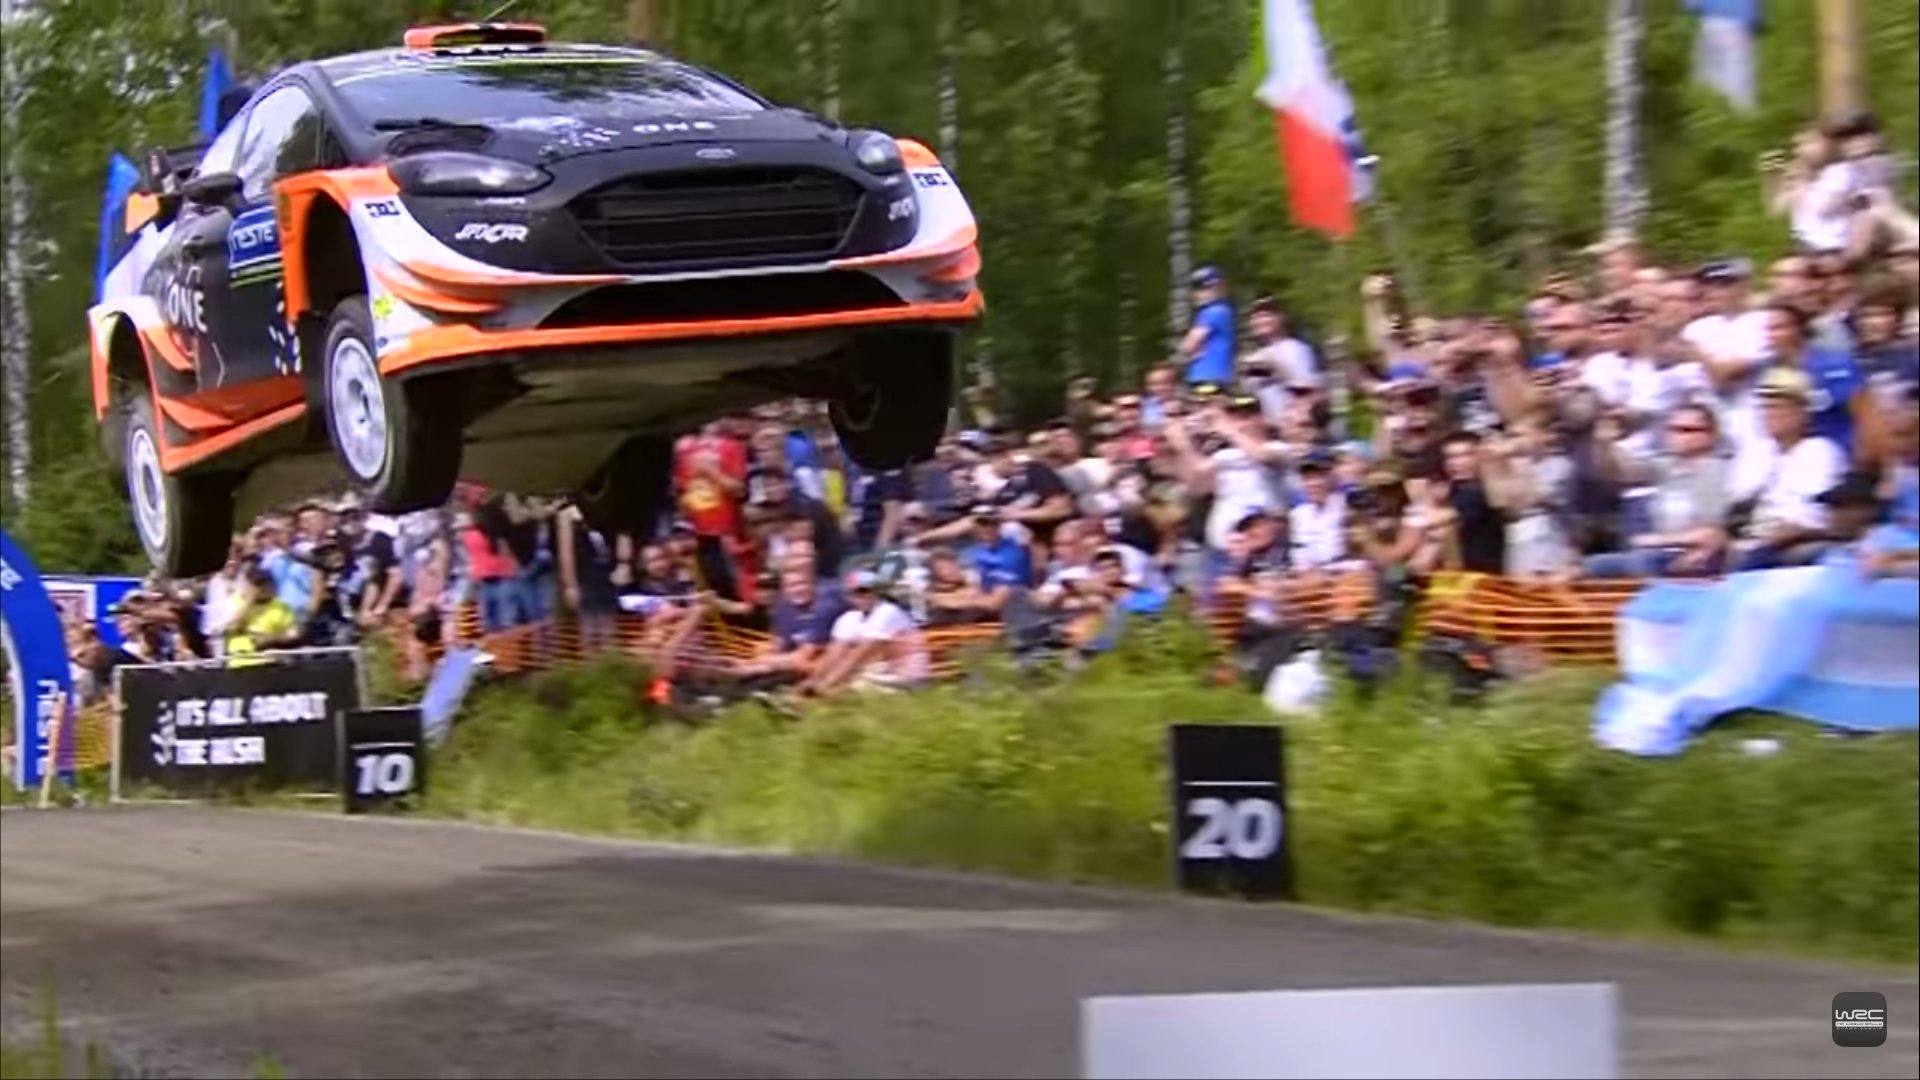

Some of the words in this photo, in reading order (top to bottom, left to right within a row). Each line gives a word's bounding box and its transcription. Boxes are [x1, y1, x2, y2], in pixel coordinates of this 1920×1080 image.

[632, 121, 717, 134] ONE
[169, 283, 207, 332] ONE
[355, 753, 415, 794] 10
[1180, 797, 1282, 859] 20
